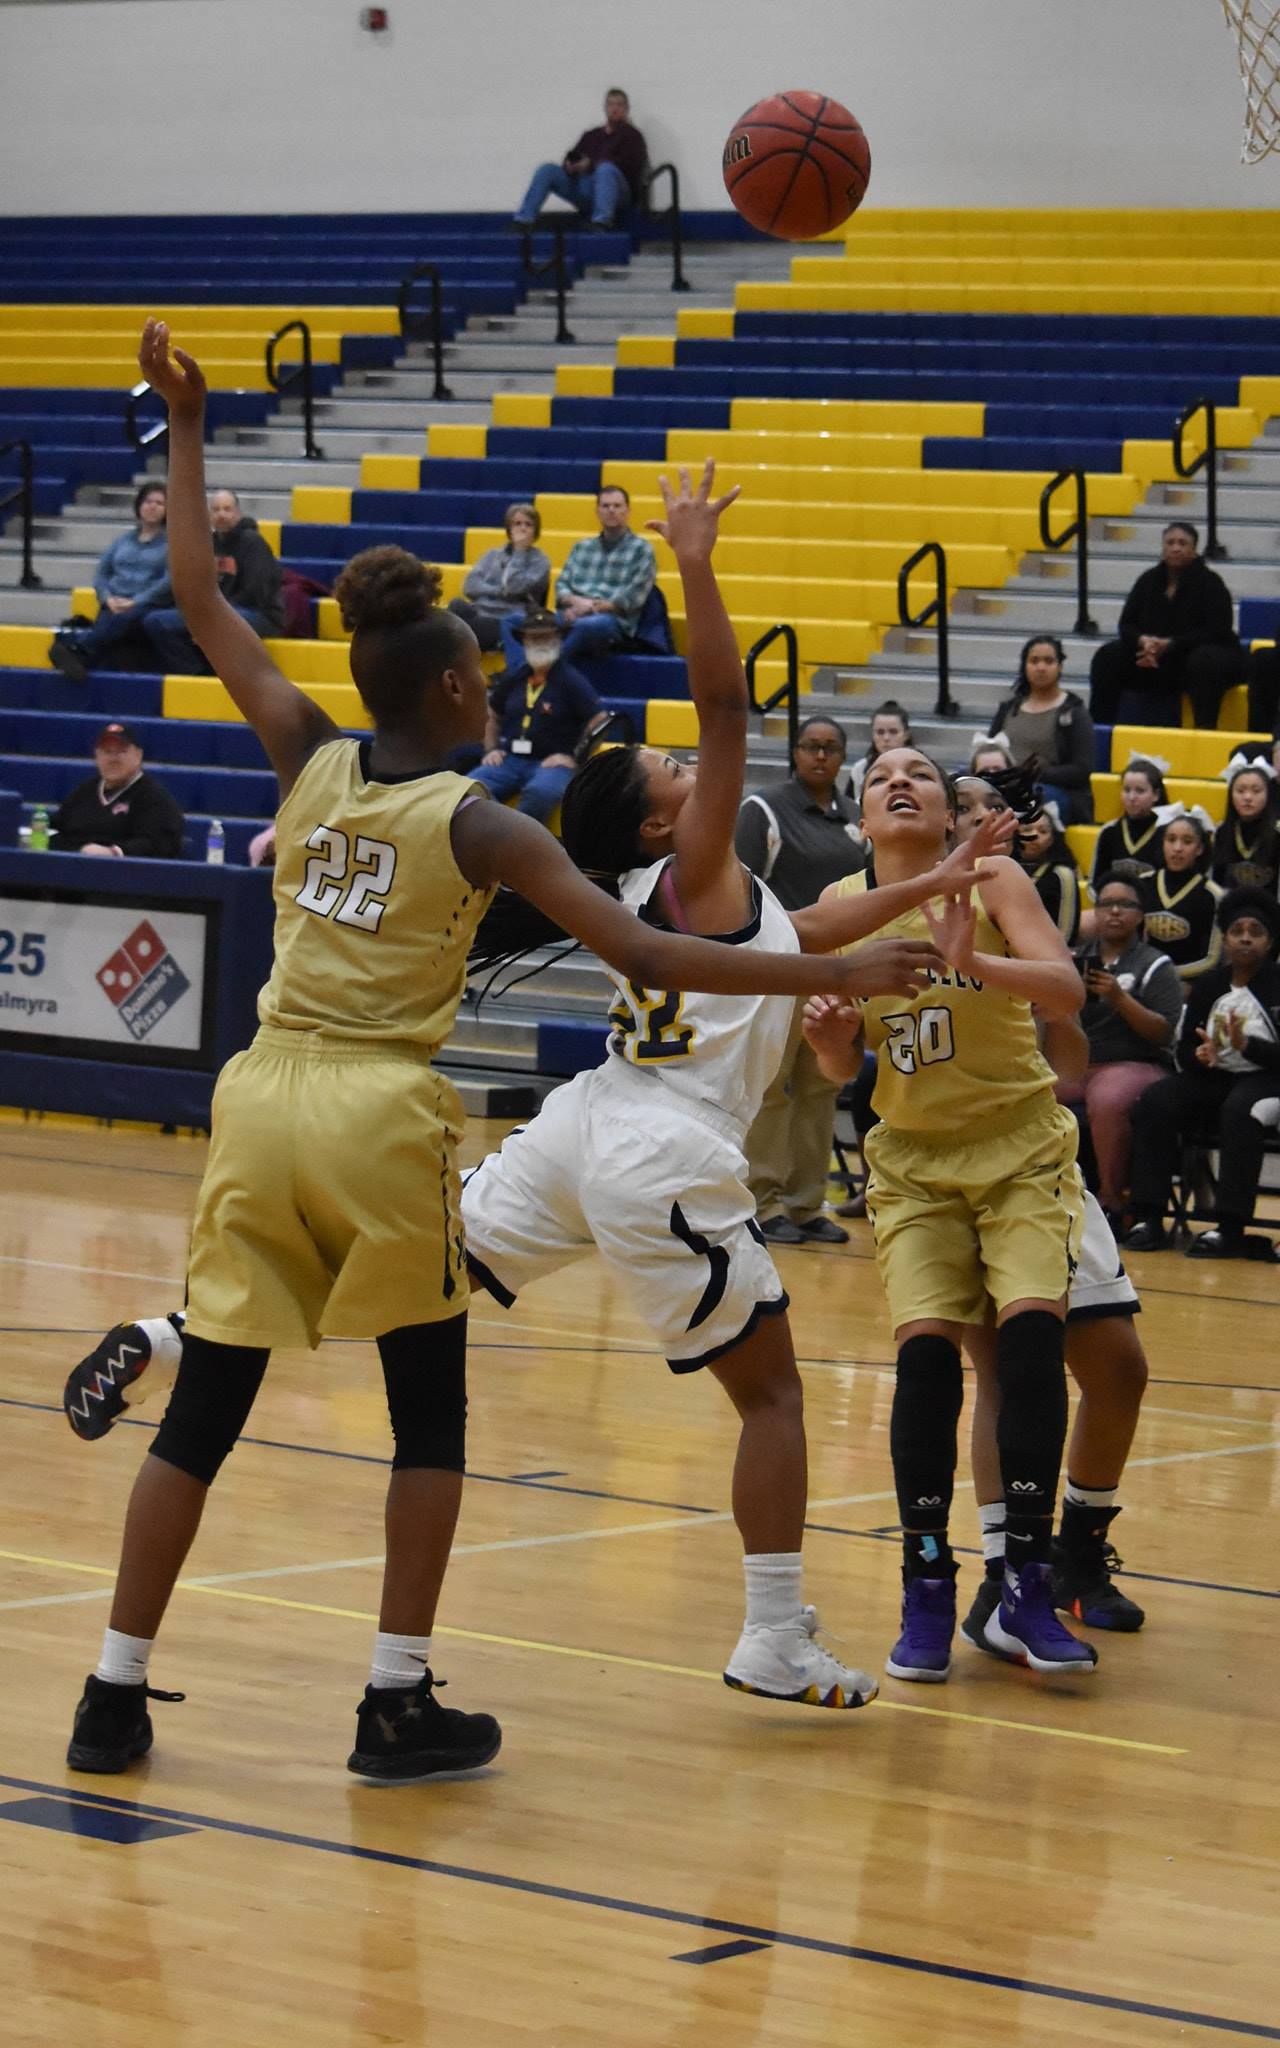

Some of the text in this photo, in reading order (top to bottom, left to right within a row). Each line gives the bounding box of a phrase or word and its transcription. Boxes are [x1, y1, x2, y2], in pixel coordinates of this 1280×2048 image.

[295, 824, 397, 934] 22
[121, 963, 175, 1022] Domino's
[880, 1006, 955, 1075] 20
